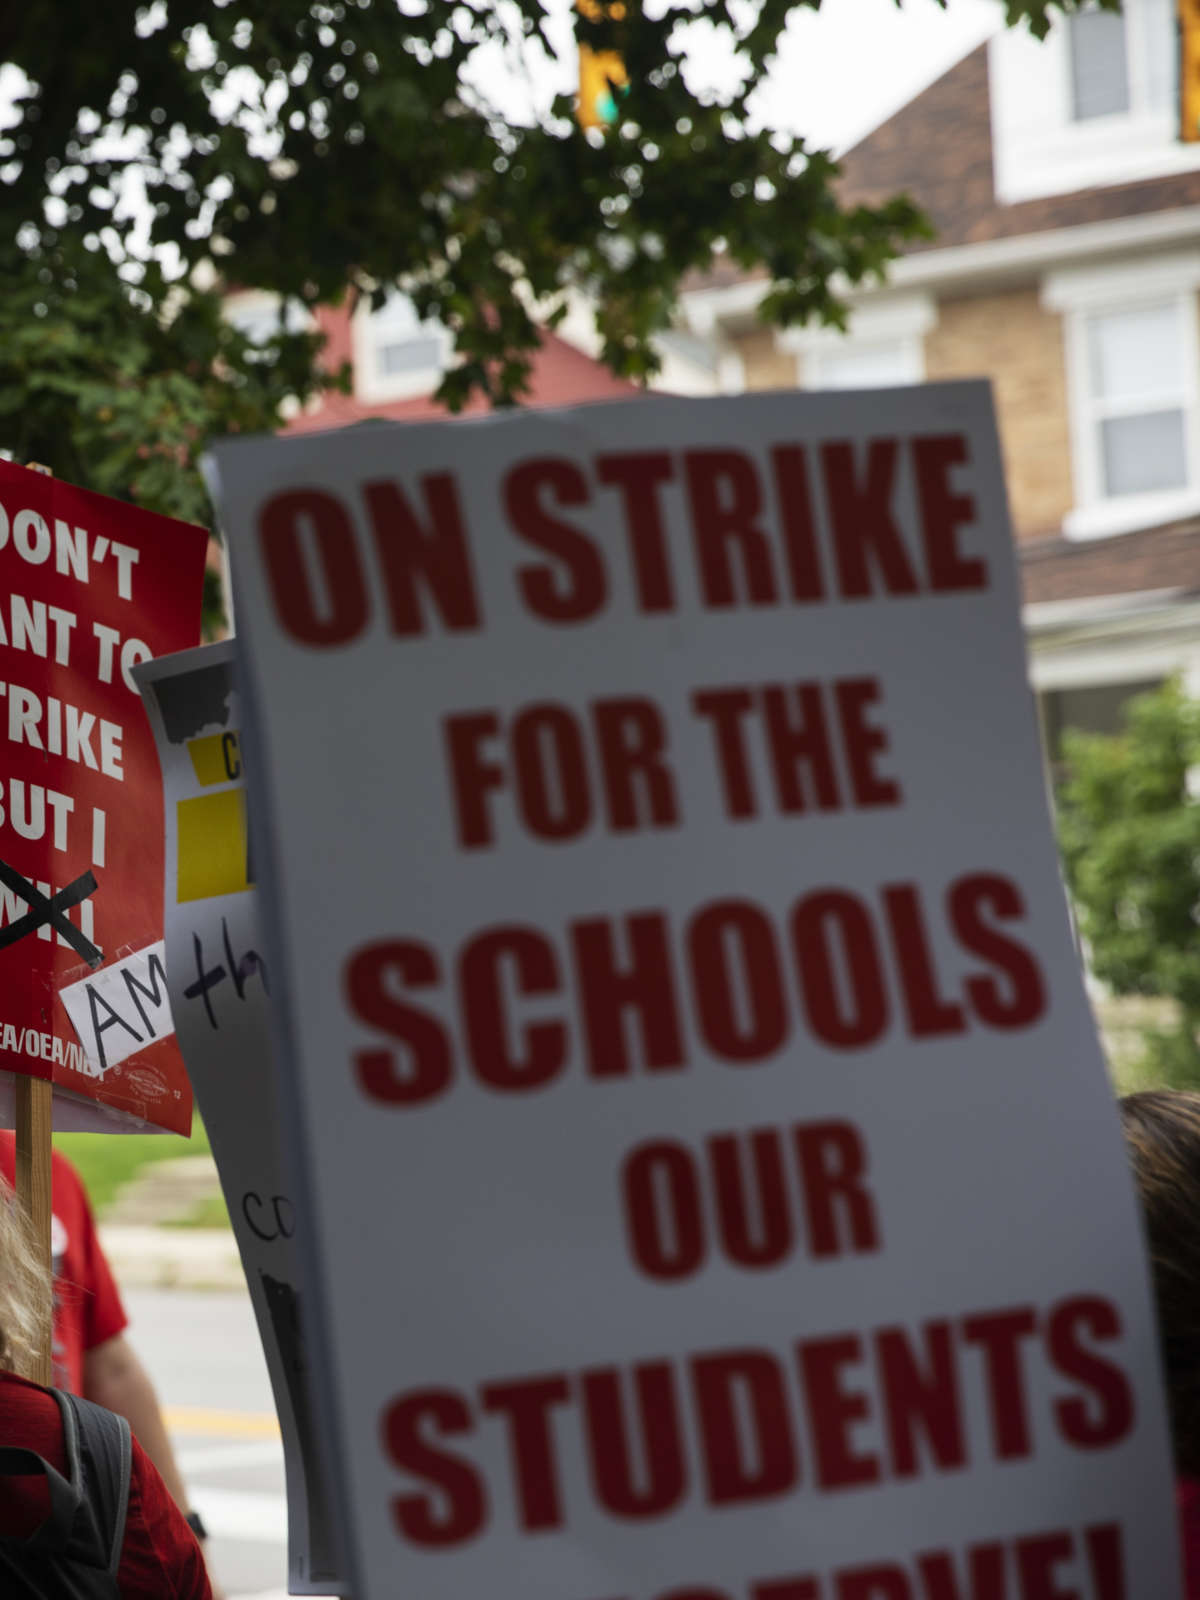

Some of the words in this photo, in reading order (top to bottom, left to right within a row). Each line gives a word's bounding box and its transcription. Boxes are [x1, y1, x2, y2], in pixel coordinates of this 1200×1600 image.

[254, 472, 482, 653] ON
[502, 434, 988, 628] STRIKE
[93, 621, 154, 696] TO
[92, 807, 106, 868] I
[442, 694, 680, 852] FOR
[692, 676, 902, 822] THE
[85, 954, 168, 1069] AM
[342, 872, 1049, 1109] SCHOOLS
[620, 1118, 881, 1284] OUR
[379, 1294, 1136, 1551] STUDENTS
